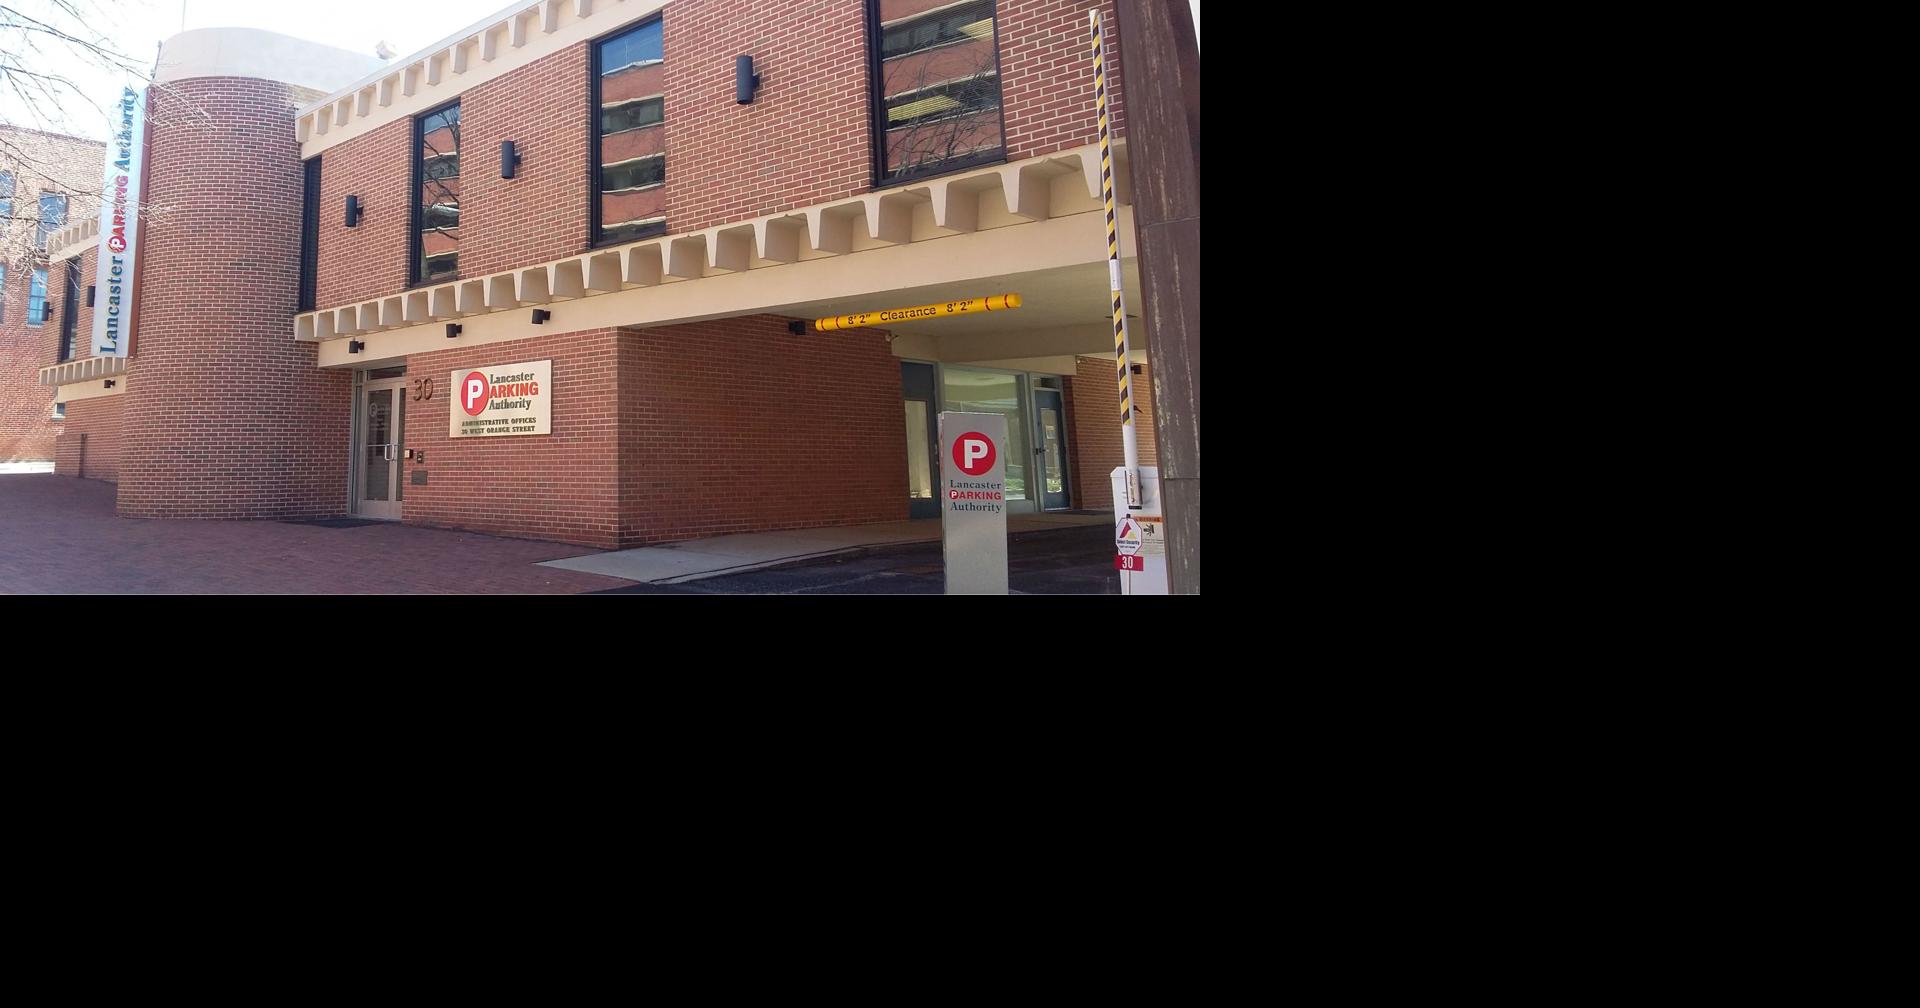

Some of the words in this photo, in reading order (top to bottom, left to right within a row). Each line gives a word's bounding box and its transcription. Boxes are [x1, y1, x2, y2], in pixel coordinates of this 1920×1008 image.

[101, 256, 124, 354] Lancaster
[880, 306, 936, 321] Clearance
[489, 372, 535, 385] Lancaster
[413, 378, 434, 401] 30
[488, 397, 532, 411] Authority
[462, 419, 509, 427] ADMINISTRATIVE
[487, 426, 510, 434] ORANGE
[964, 439, 988, 468] P
[950, 479, 1002, 490] Lancaster
[949, 490, 1002, 500] PARKING
[950, 501, 1002, 514] Authority
[1122, 556, 1134, 569] 30
